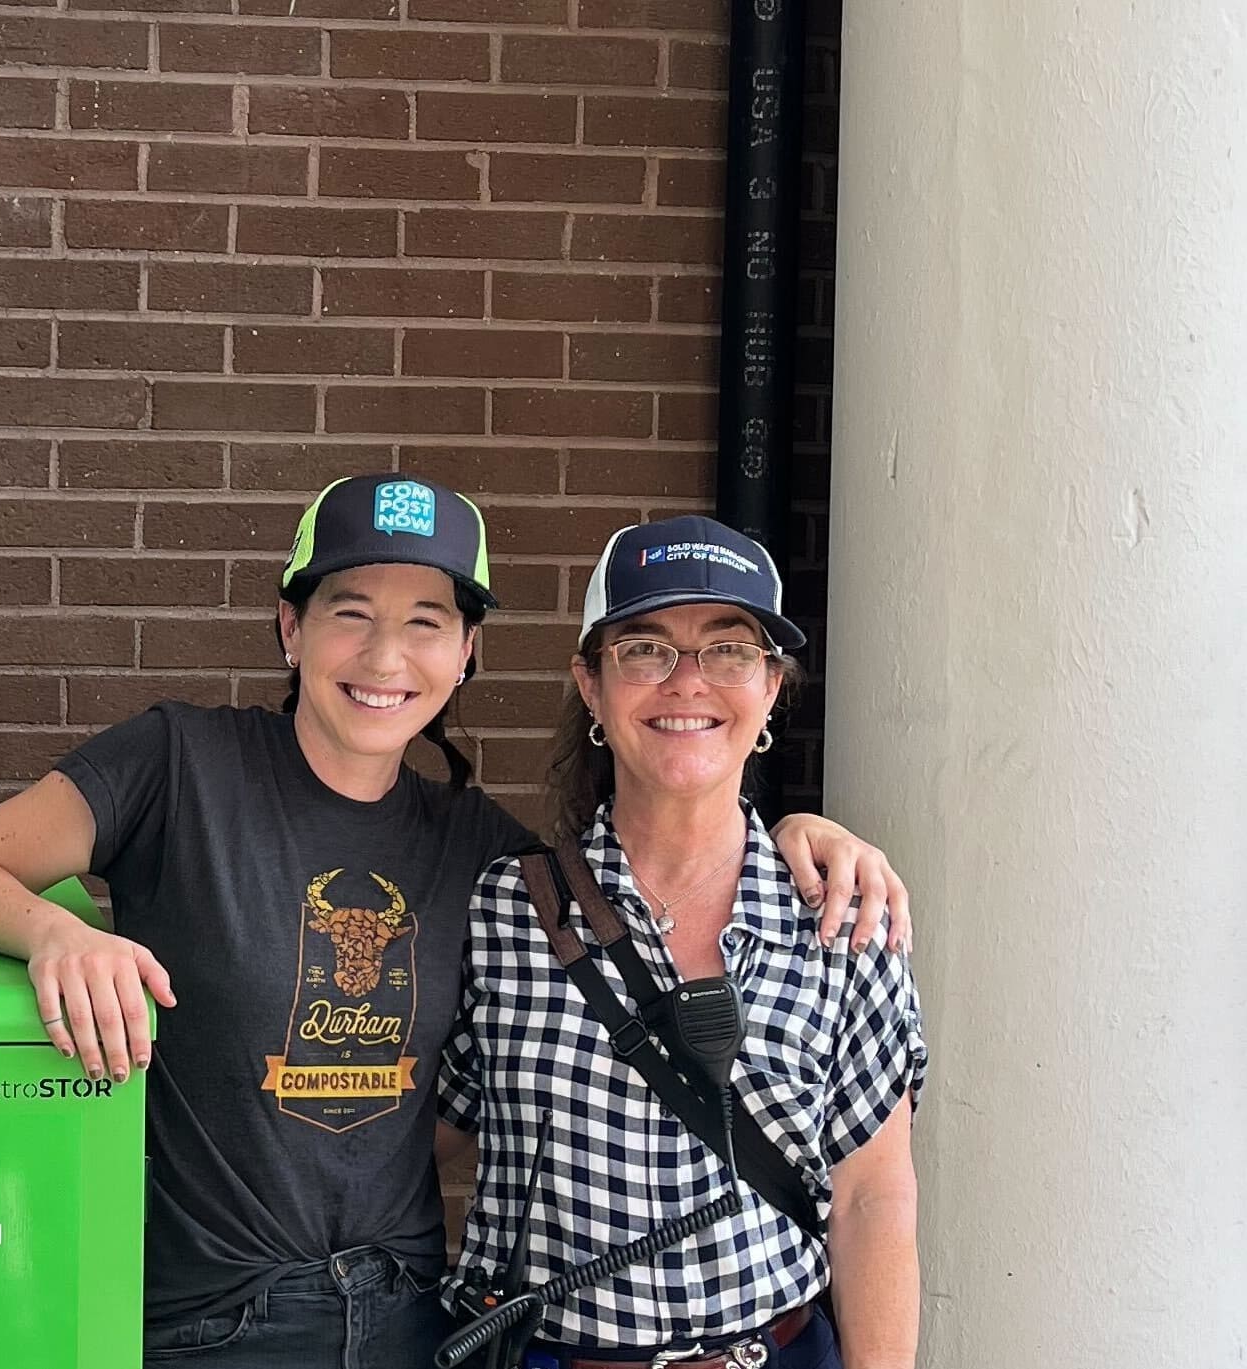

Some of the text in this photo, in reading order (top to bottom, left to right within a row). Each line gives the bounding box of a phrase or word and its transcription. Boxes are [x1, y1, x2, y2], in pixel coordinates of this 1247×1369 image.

[749, 67, 781, 148] USA
[379, 484, 431, 502] COM
[379, 499, 432, 516] POST
[378, 513, 432, 531] NOW
[666, 551, 691, 561] CITY
[692, 552, 708, 561] OF
[299, 999, 401, 1045] Durham
[281, 1070, 397, 1091] COMPOSTABLE
